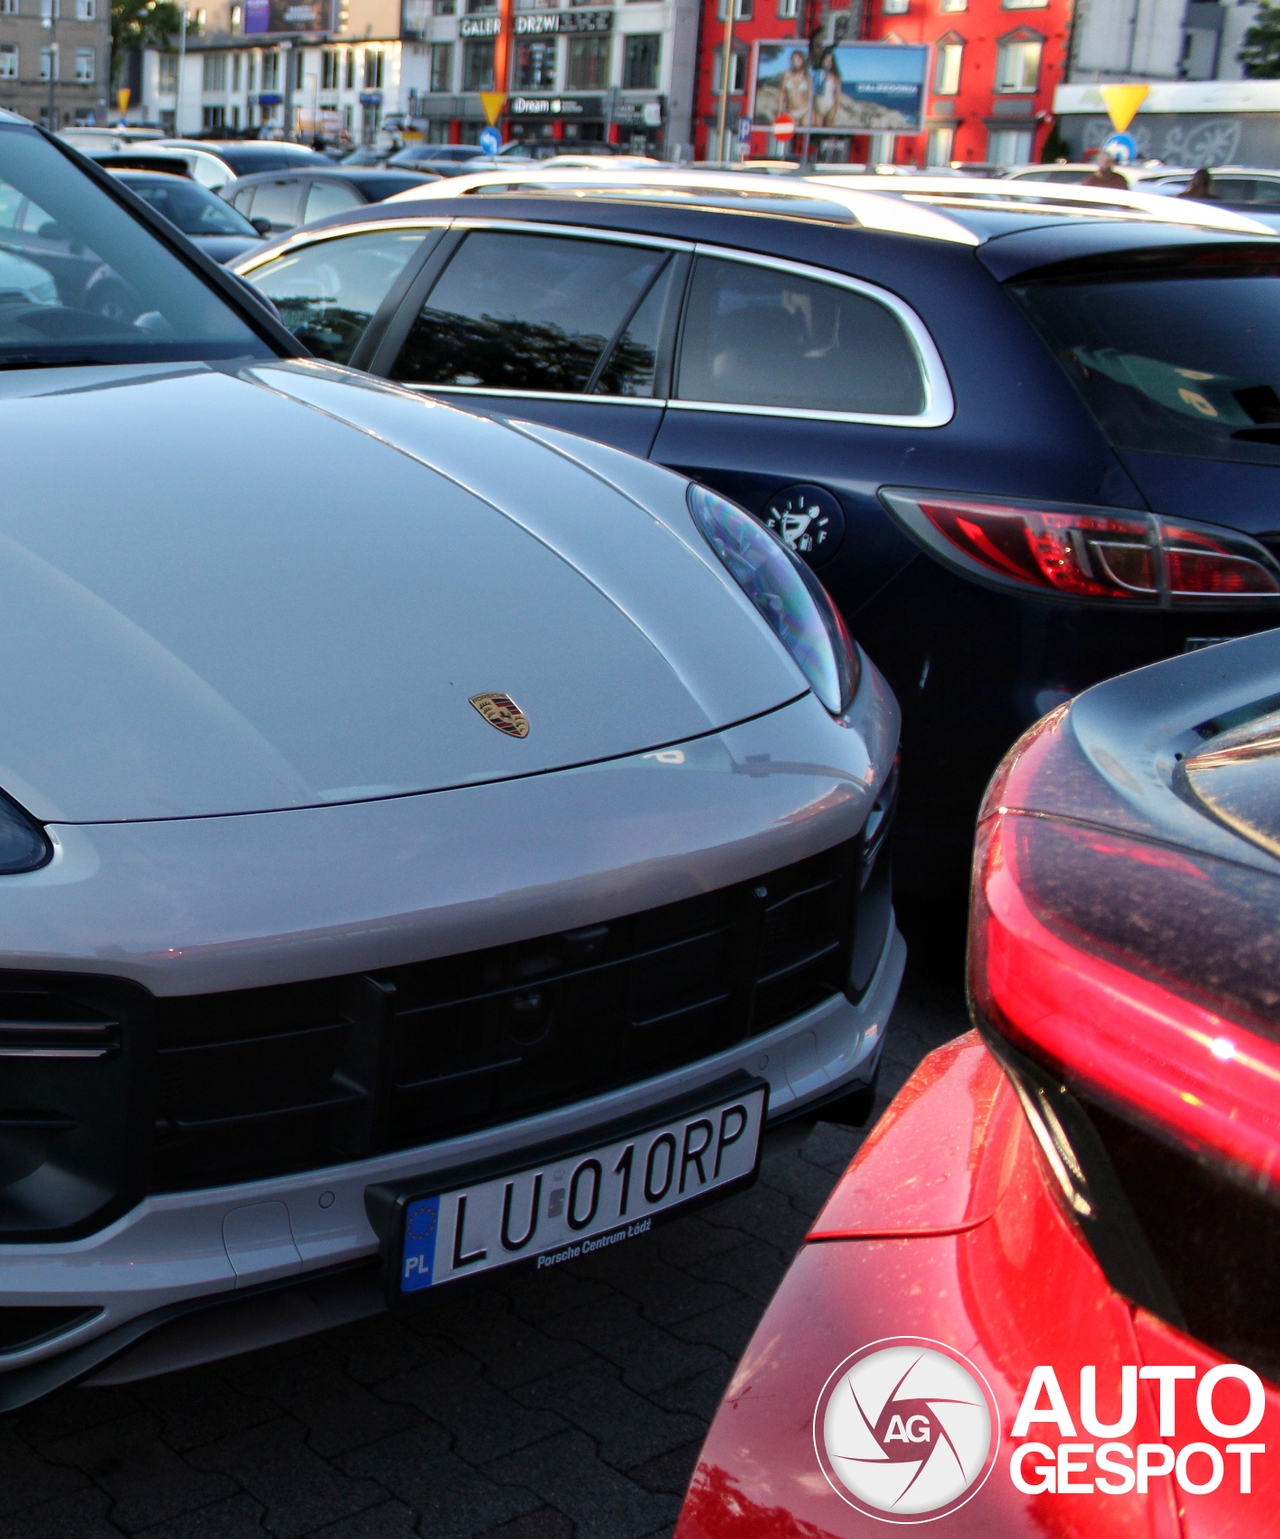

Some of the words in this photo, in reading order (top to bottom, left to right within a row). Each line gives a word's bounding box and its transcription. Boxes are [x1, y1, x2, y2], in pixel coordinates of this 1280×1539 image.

[461, 16, 502, 36] GALER
[516, 15, 560, 34] DRZWI
[512, 97, 550, 114] iDream
[817, 530, 827, 544] F
[451, 1171, 543, 1269] LU
[537, 1247, 581, 1270] Porsche
[581, 1229, 627, 1254] Centrum
[627, 1218, 652, 1238] Łódź
[405, 1256, 429, 1278] PL
